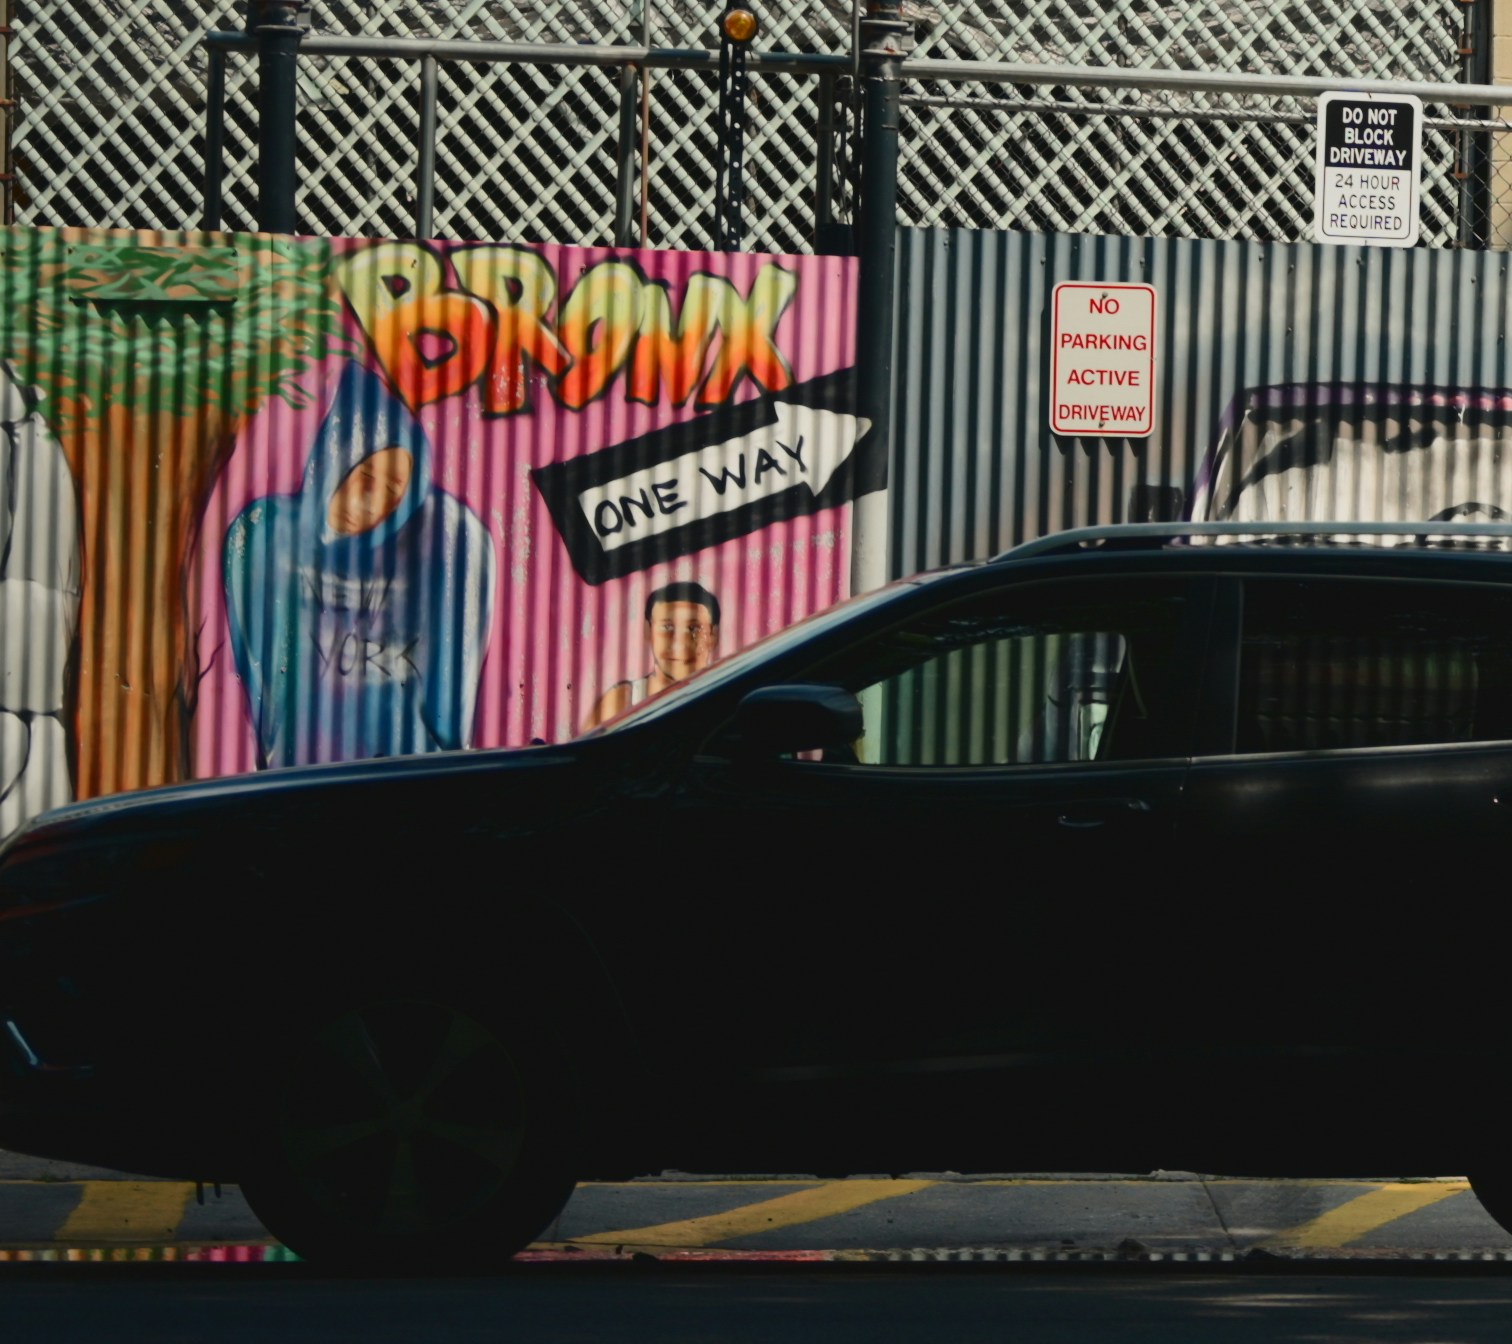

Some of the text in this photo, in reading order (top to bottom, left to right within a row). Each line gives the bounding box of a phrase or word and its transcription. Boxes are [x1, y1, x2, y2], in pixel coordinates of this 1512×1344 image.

[1342, 107, 1398, 126] DO NOT
[1344, 127, 1394, 146] BLOCK
[1330, 147, 1407, 166] DRIVEWAY
[1335, 173, 1400, 190] 24 HOUR
[1338, 194, 1396, 210] ACCESS
[1330, 214, 1402, 231] REQUIRED
[1089, 298, 1120, 315] NO
[334, 242, 798, 419] BRONX
[1060, 333, 1147, 351] PARKING
[1067, 369, 1140, 386] ACTIVE
[1059, 404, 1146, 422] DRIVEWAY
[594, 435, 808, 536] ONE WAY
[301, 566, 393, 619] NEW
[309, 631, 424, 685] YORK
